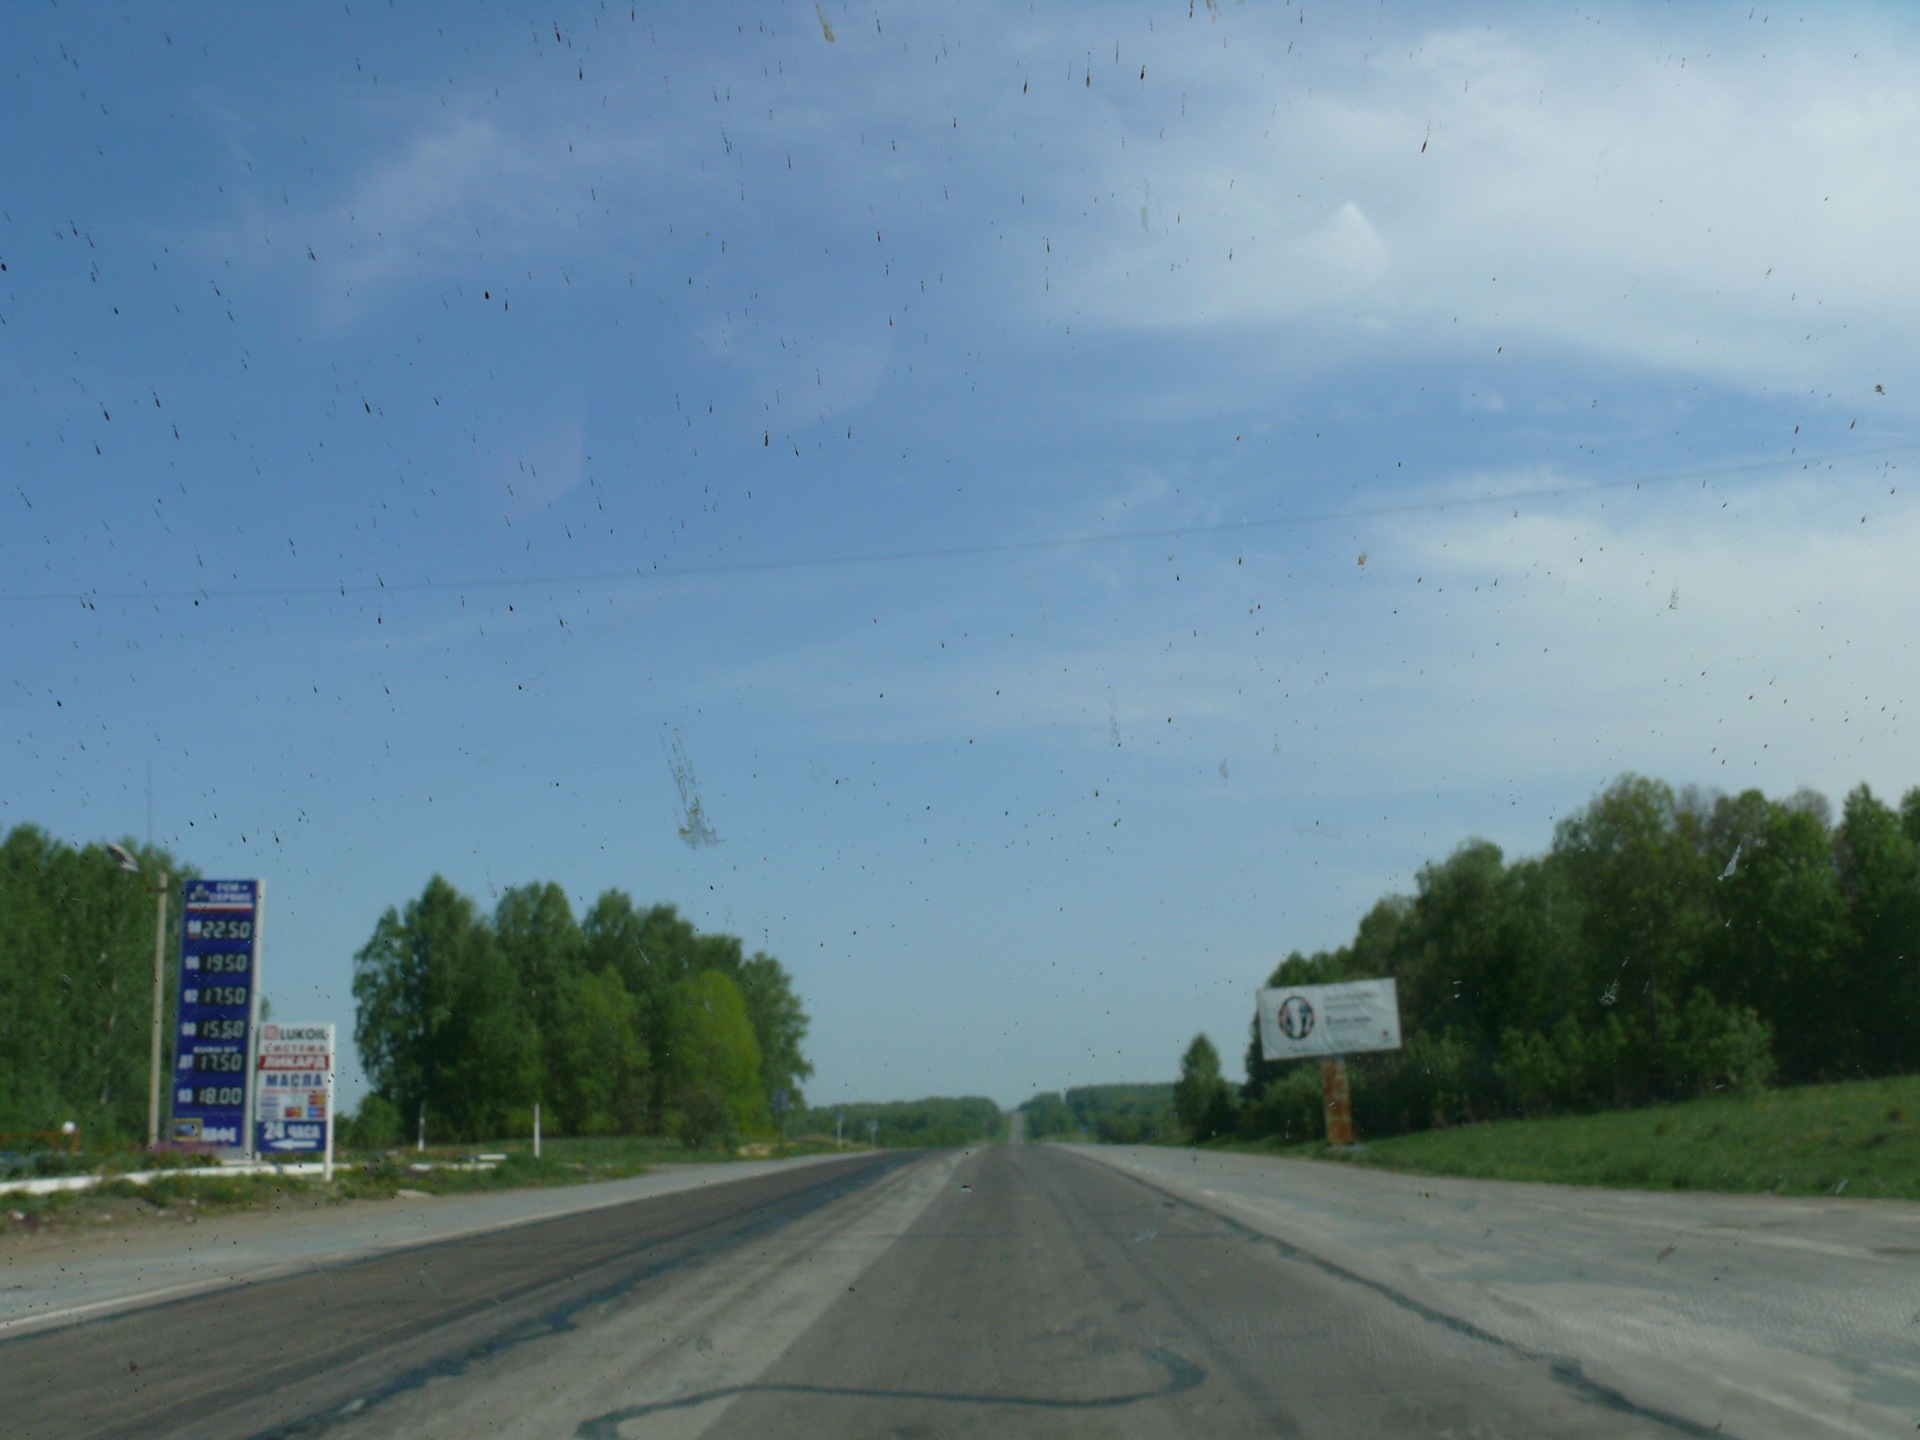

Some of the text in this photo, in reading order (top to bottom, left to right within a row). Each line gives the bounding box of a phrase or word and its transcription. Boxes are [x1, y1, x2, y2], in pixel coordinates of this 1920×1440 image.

[280, 1027, 327, 1040] LUKOIL
[266, 1073, 322, 1088] МАСЛА
[264, 1121, 285, 1140] 24
